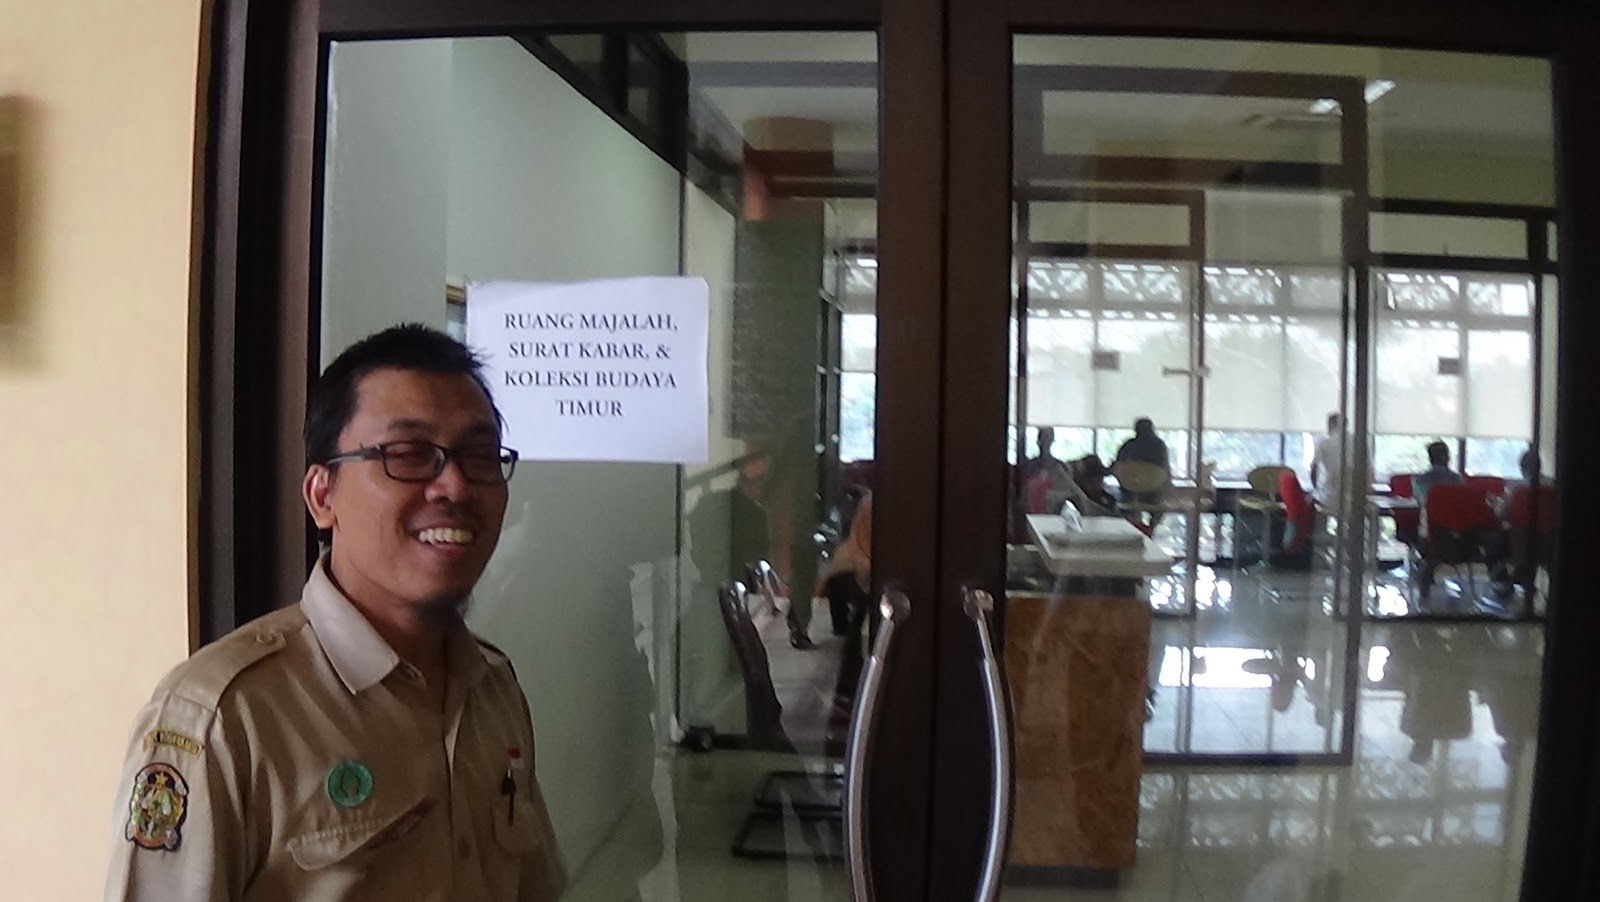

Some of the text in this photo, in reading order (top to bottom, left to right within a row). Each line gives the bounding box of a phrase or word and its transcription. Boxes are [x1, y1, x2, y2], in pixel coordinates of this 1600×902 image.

[504, 313, 678, 333] RUANG MAJALAH,
[508, 342, 672, 361] SURAT KABAR, &
[504, 371, 677, 388] KOLEKSI BUDAYA
[555, 400, 623, 417] TIMUR
